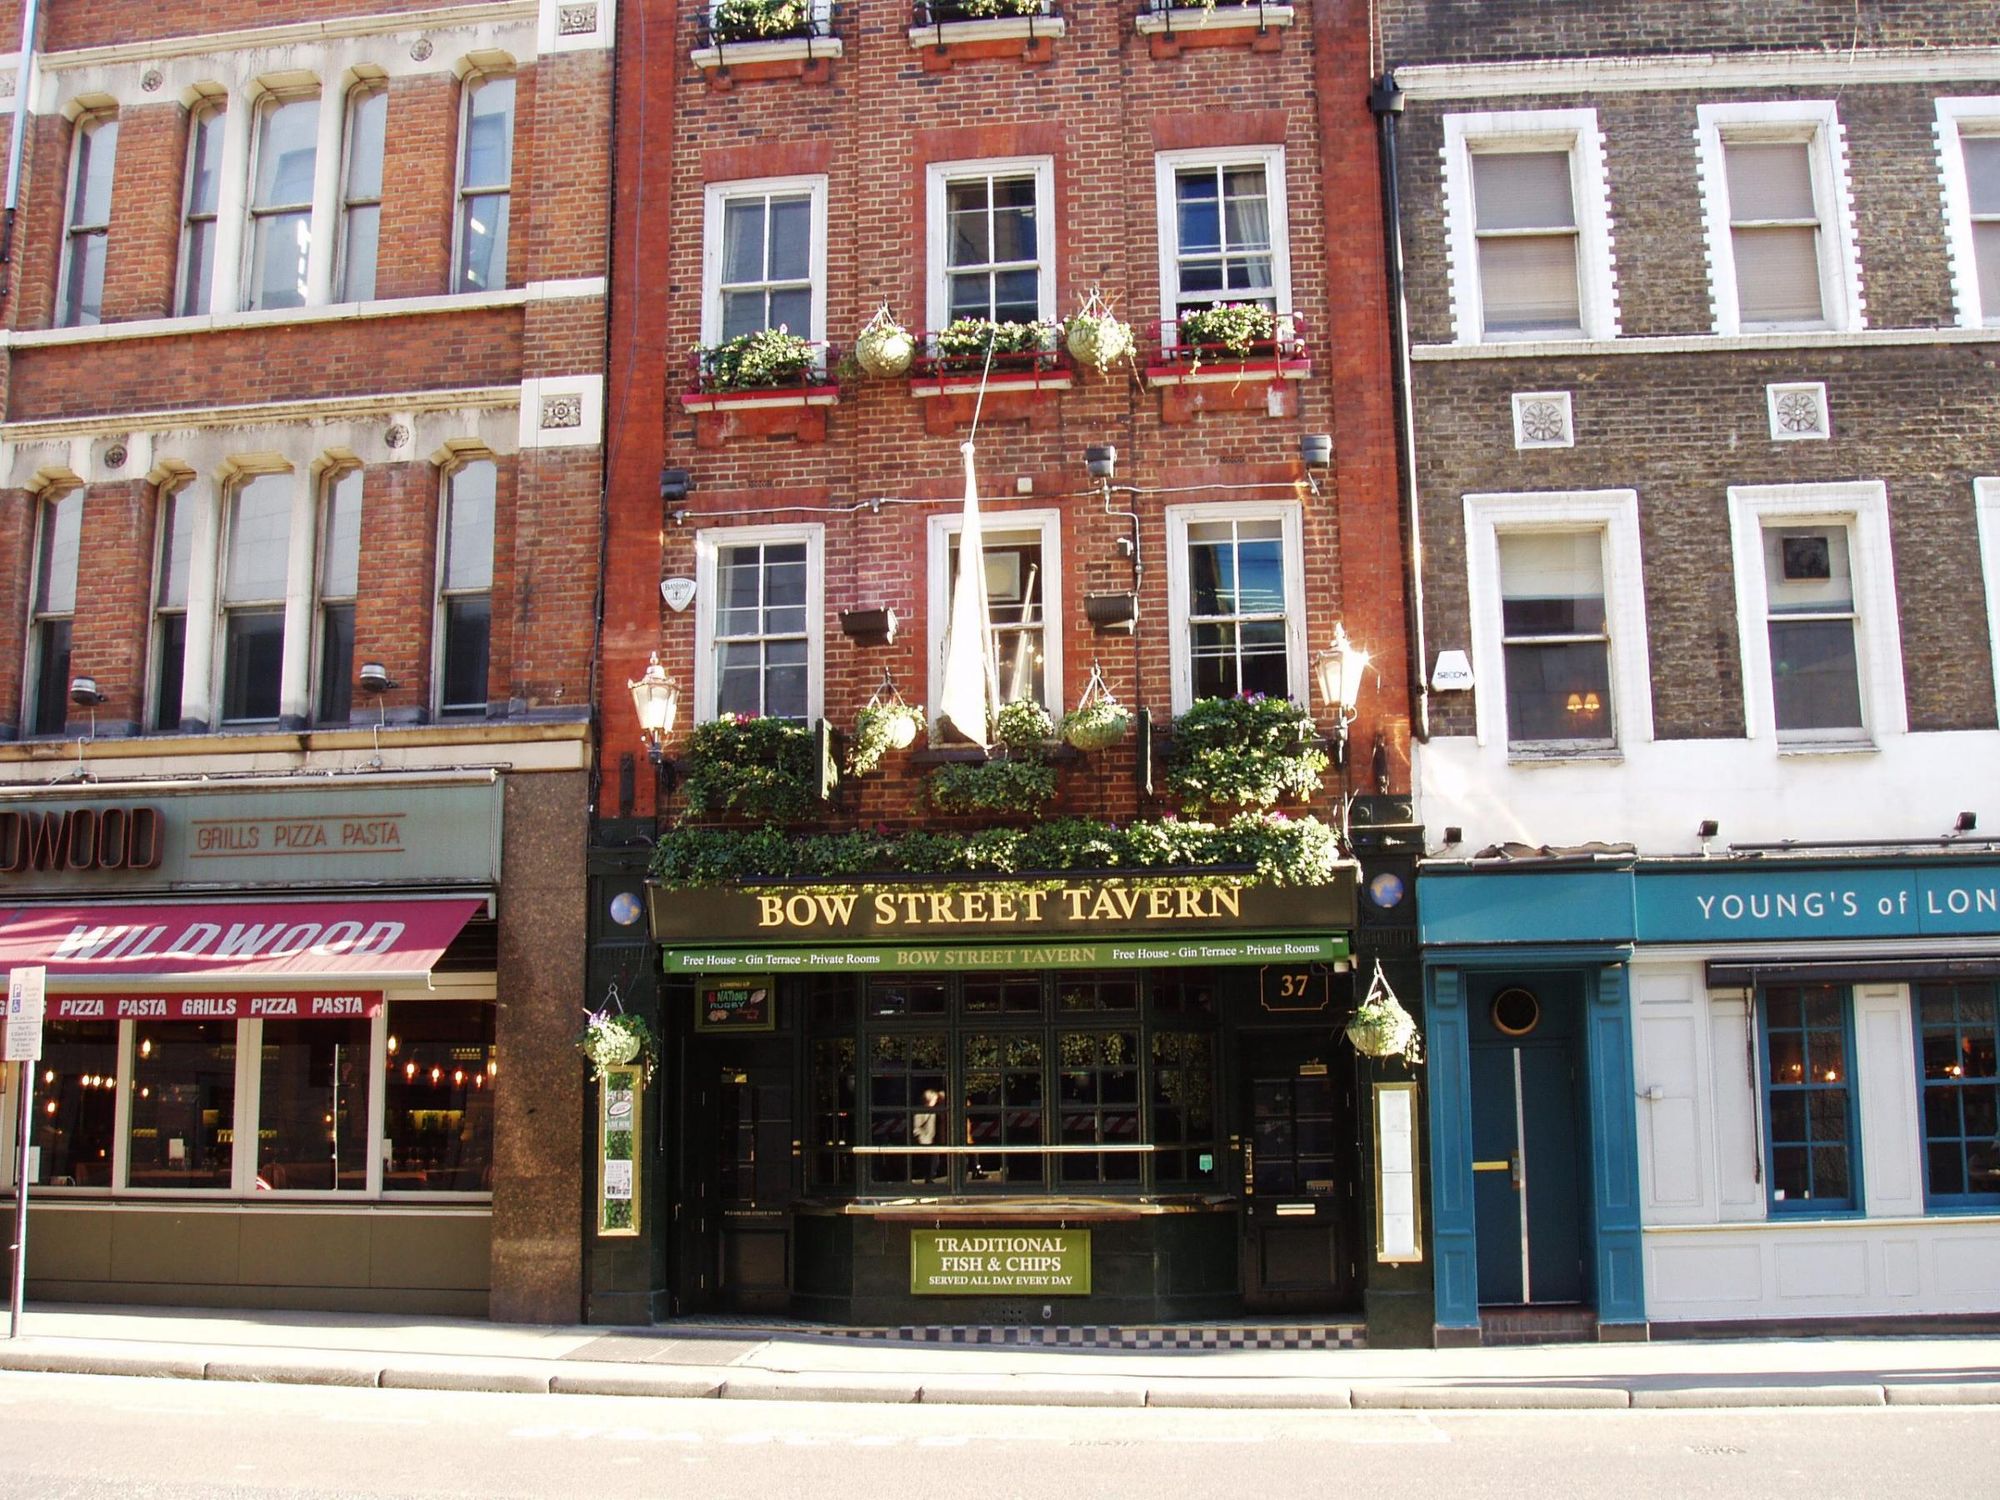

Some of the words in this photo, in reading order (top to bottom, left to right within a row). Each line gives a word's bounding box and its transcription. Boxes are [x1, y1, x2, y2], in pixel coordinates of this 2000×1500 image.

[198, 825, 260, 851] GRILLS
[273, 823, 328, 848] PIZZA
[342, 821, 401, 846] PASTA
[756, 893, 859, 927] BOW
[874, 890, 1048, 925] STREET
[1062, 885, 1244, 921] TAVERN
[1696, 891, 1859, 920] YOUNG'S
[1877, 890, 1907, 916] of
[1926, 888, 1998, 915] LON
[50, 921, 406, 961] WILDWOOD
[682, 955, 704, 966] Free
[706, 955, 737, 966] House
[745, 954, 764, 965] Gin
[766, 954, 801, 965] Terrace
[810, 953, 844, 964] Private
[846, 953, 881, 964] Rooms
[896, 951, 940, 965] BOW
[944, 949, 1011, 965] STREET
[1019, 947, 1097, 964] TAVERN
[1112, 948, 1135, 960] Free
[1137, 948, 1169, 959] House
[1178, 947, 1198, 959] Gin
[1199, 946, 1237, 958] Terrace
[1246, 944, 1282, 956] Private
[1284, 943, 1320, 955] Rooms
[1280, 974, 1309, 997] 37
[59, 999, 105, 1016] PIZZA
[116, 998, 168, 1016] PASTA
[180, 998, 238, 1016] GRILLS
[249, 998, 298, 1015] PIZZA
[311, 996, 364, 1014] PASTA
[934, 1237, 1068, 1253] TRADITIONAL
[940, 1256, 984, 1272] FISH
[986, 1257, 1002, 1272] &
[1005, 1256, 1062, 1272] CHIPS
[928, 1276, 969, 1285] SERVED
[970, 1276, 991, 1285] ALL
[993, 1276, 1014, 1285] DAY
[1016, 1275, 1049, 1285] EVERY
[1051, 1275, 1073, 1285] DAY
